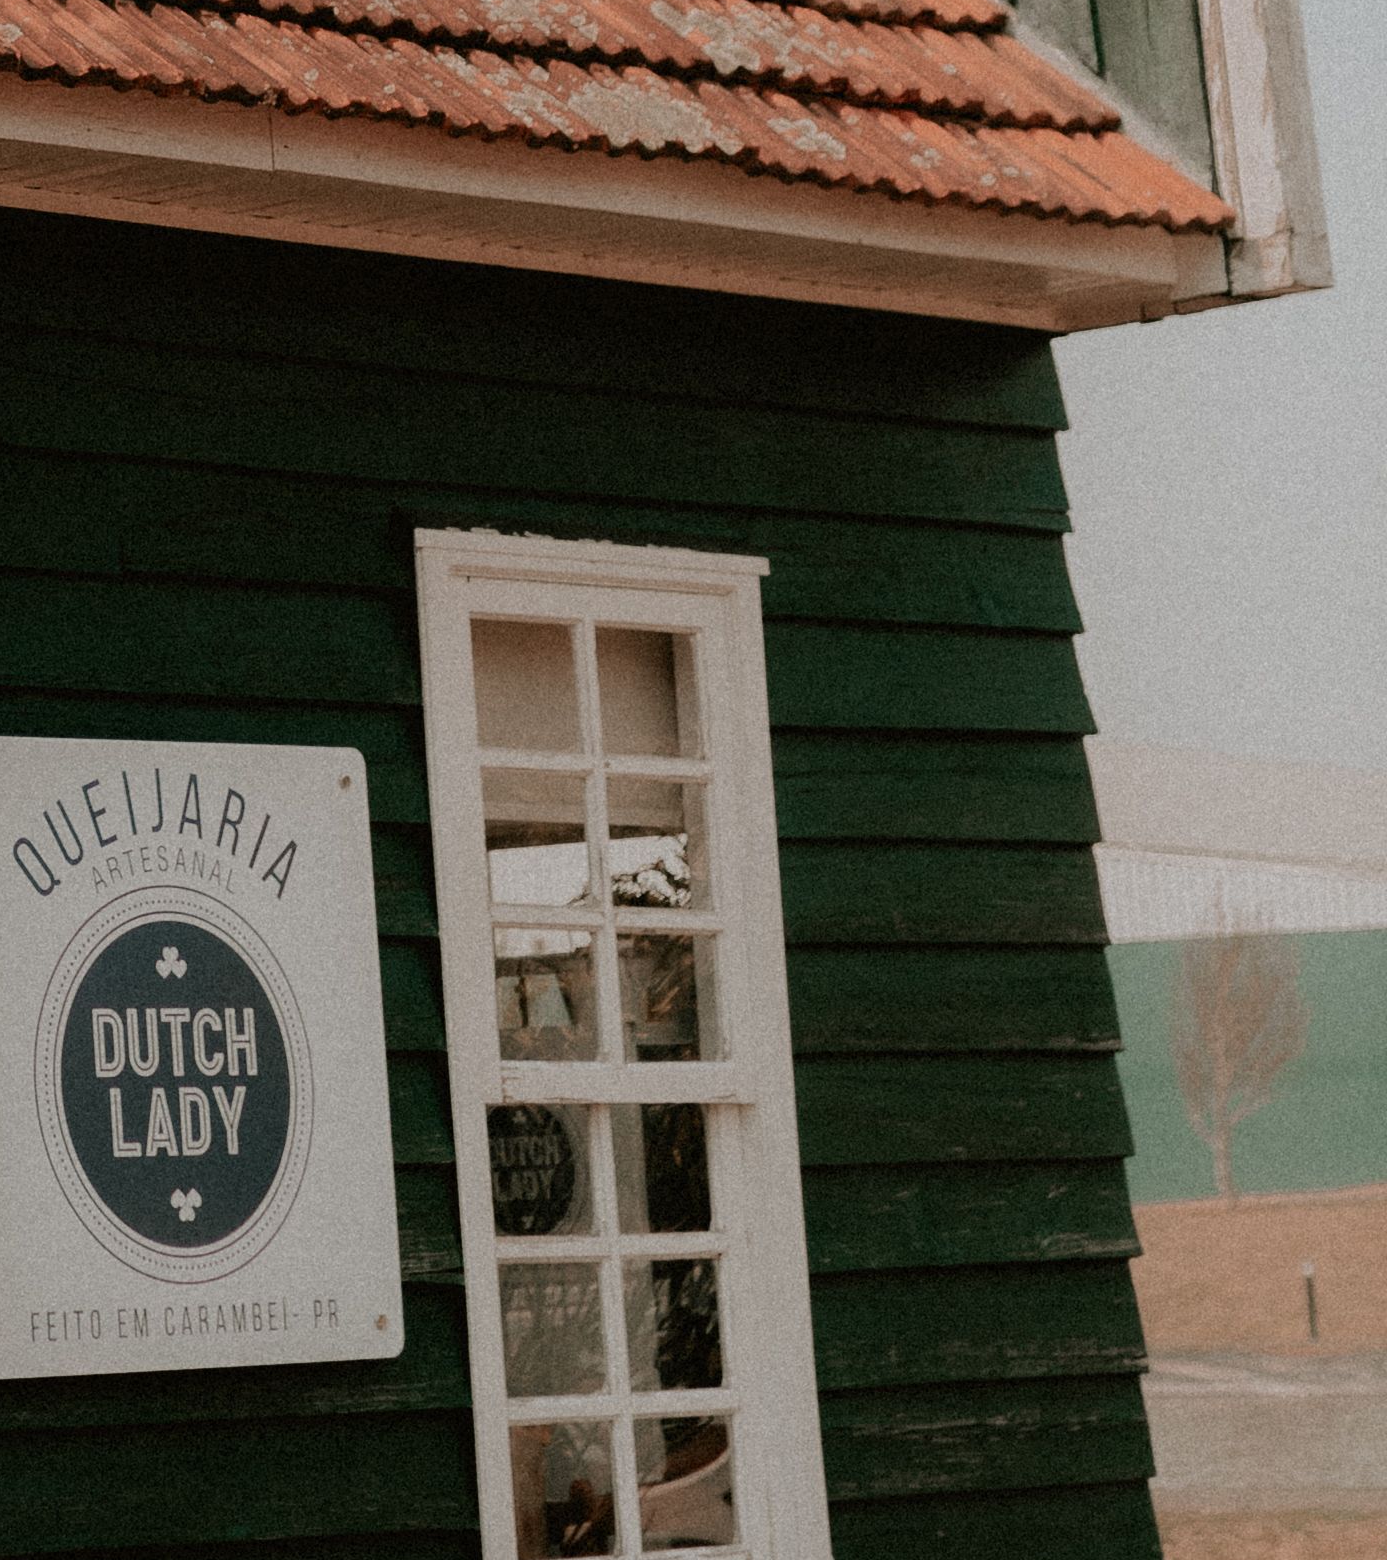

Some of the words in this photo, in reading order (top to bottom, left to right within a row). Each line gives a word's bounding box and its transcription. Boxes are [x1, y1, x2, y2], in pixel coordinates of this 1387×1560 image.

[12, 767, 299, 898] QUEIJARIA
[91, 844, 234, 894] ARTESANAL
[90, 1006, 259, 1079] DUTCH
[109, 1085, 248, 1159] LADY
[29, 1309, 102, 1342] FEITO
[117, 1307, 149, 1338] EM
[313, 1299, 340, 1329] PR
